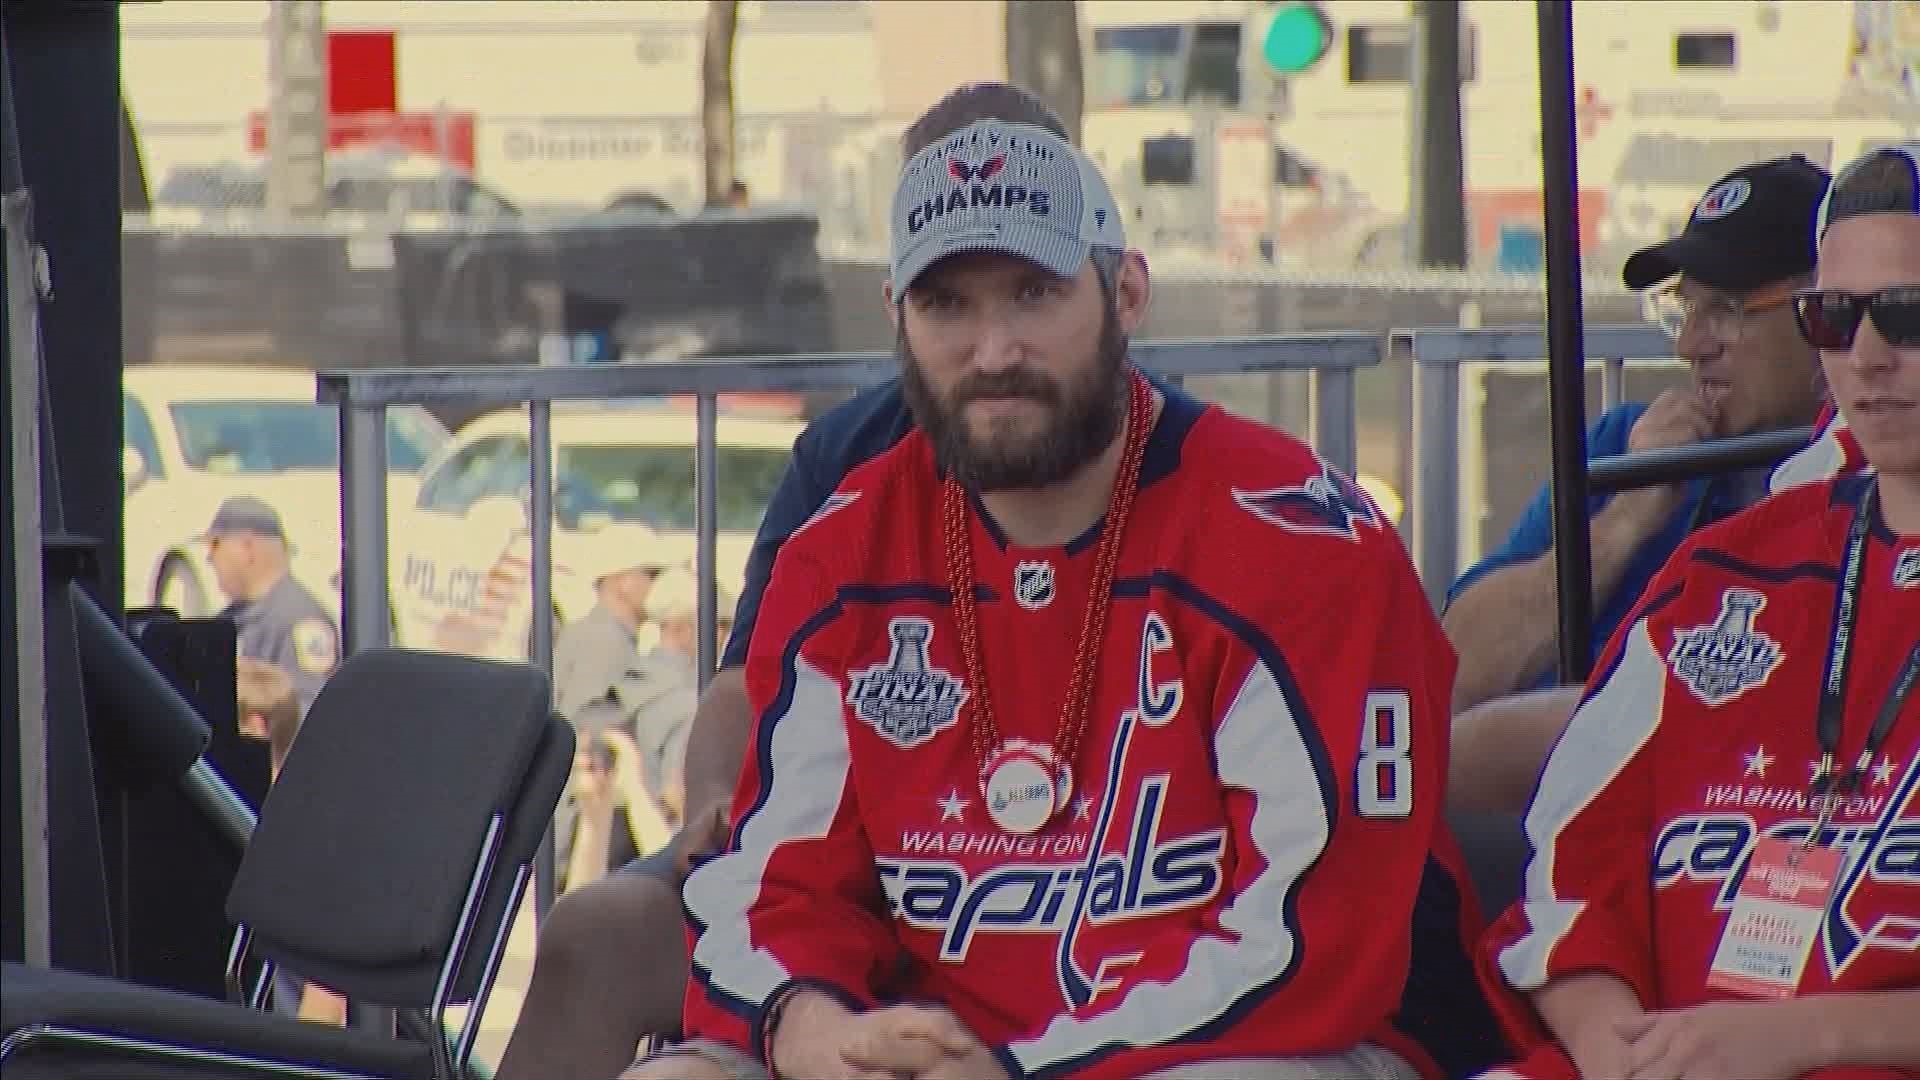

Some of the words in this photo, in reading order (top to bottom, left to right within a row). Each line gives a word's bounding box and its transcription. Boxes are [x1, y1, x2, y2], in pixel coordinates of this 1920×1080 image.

[907, 184, 1050, 234] CHAMPS
[1845, 536, 1865, 587] FINAL
[1840, 588, 1854, 623] CUP
[1138, 610, 1184, 727] C
[1681, 637, 1772, 664] FINAL
[1828, 623, 1849, 695] STANLEY
[856, 678, 959, 702] FINAL
[1356, 688, 1413, 817] 8
[901, 831, 1087, 857] WASHINGTON
